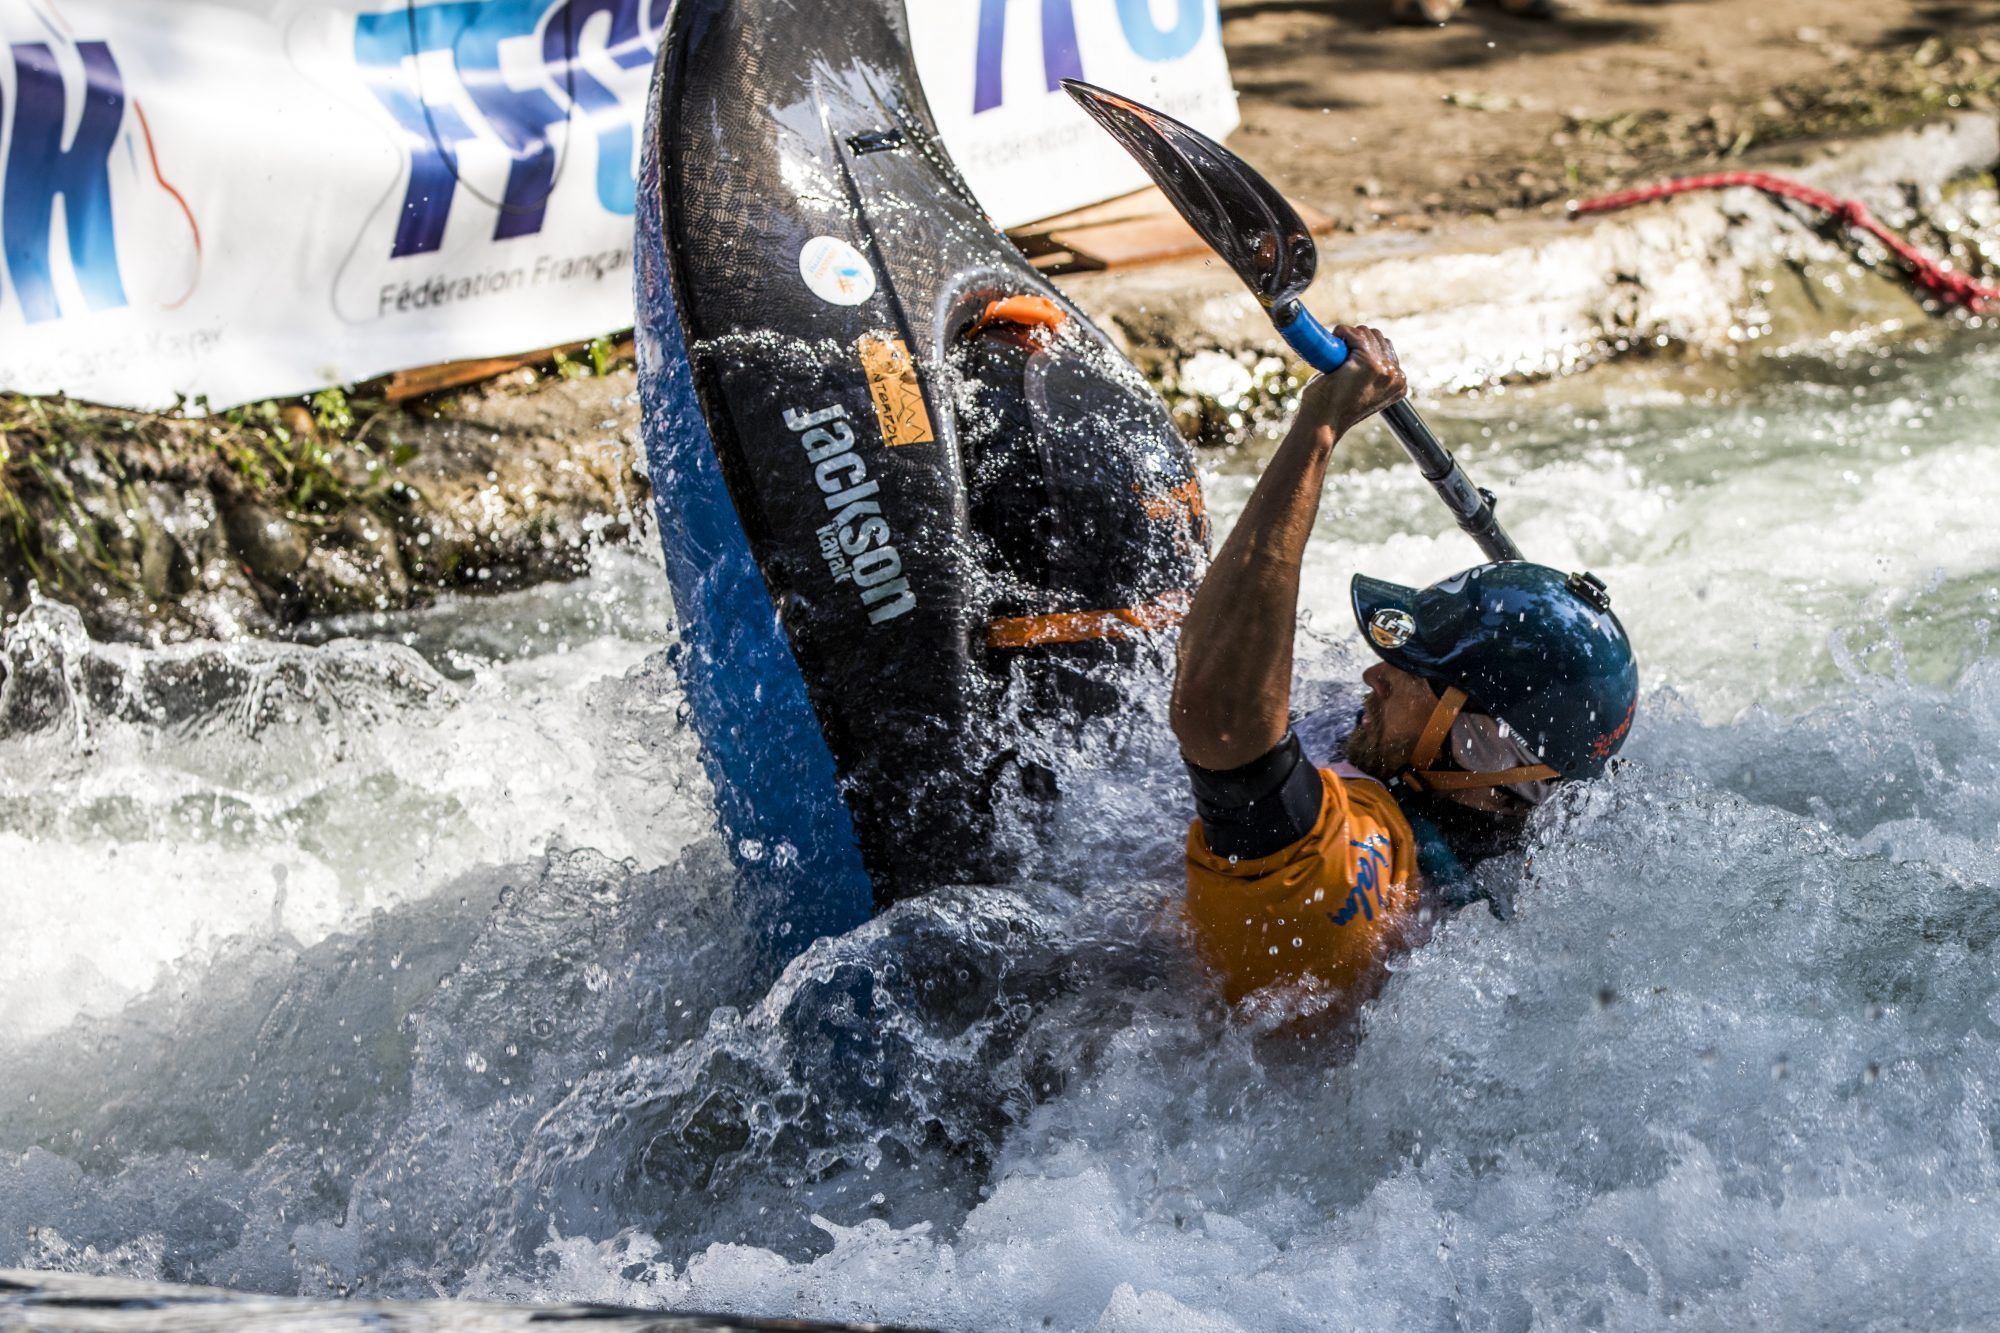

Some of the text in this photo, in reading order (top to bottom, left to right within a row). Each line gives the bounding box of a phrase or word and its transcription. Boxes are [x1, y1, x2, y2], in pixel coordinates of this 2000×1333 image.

[354, 0, 670, 258] FFC
[378, 246, 632, 318] Fédération Françai
[815, 523, 852, 584] kayak
